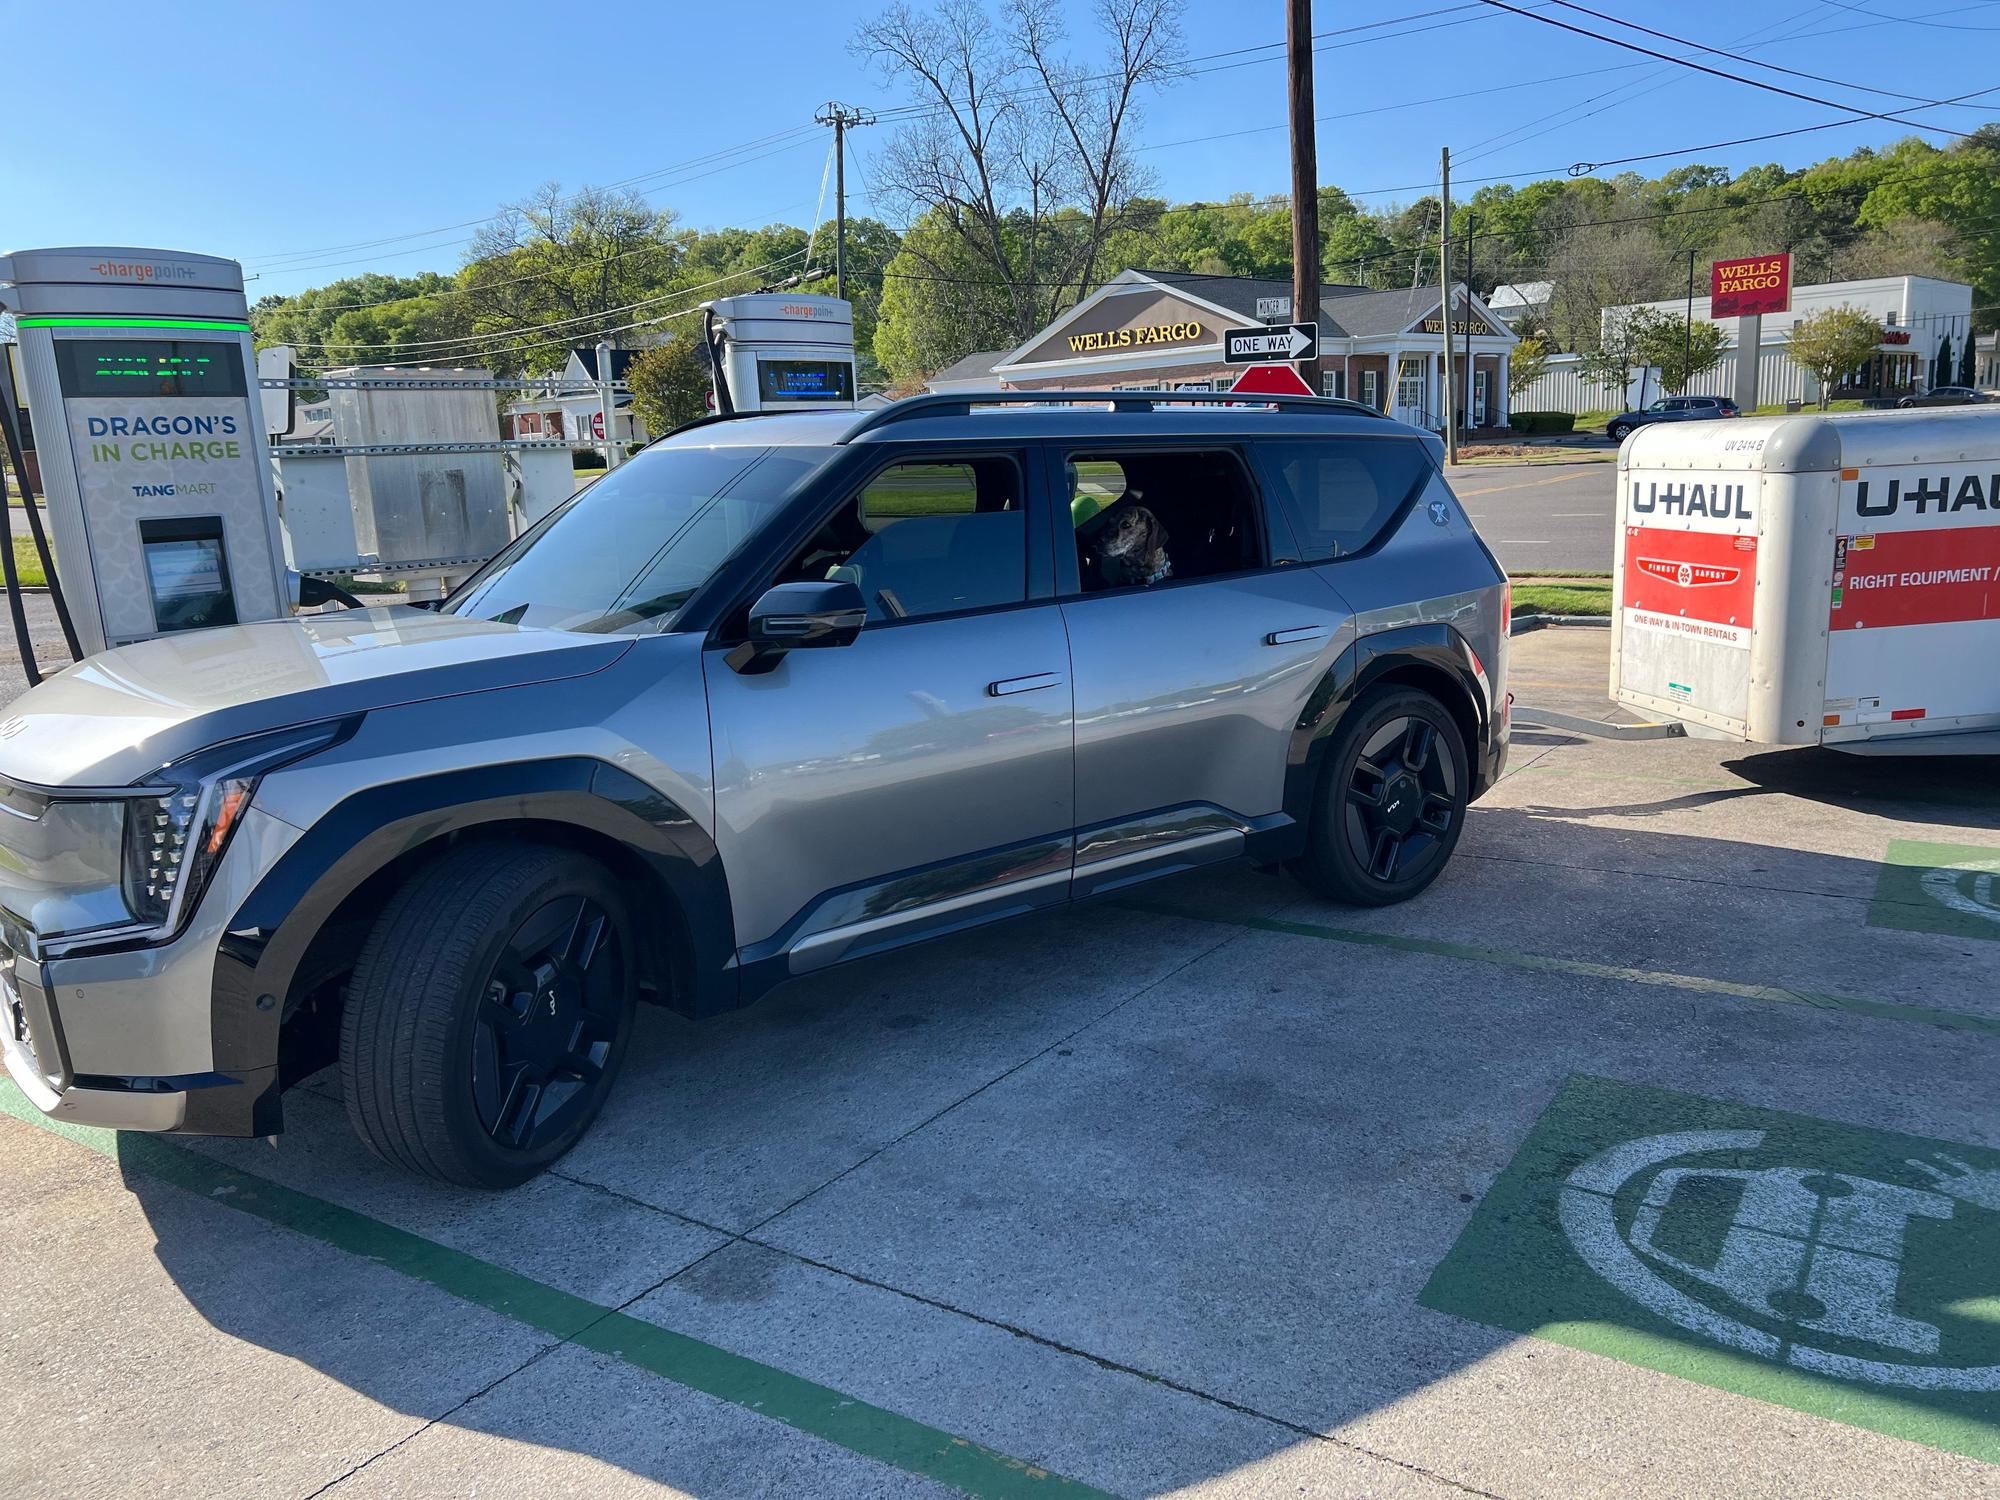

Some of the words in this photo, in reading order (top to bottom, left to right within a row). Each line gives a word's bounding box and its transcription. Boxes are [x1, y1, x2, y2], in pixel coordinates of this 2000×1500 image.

[1718, 260, 1782, 280] WELLS
[1719, 275, 1781, 294] FARGO
[1424, 319, 1457, 334] WELS
[1067, 328, 1132, 353] WELLS
[1134, 321, 1202, 345] FARGO
[1234, 338, 1260, 353] ONE
[1267, 336, 1294, 351] WAY
[88, 416, 237, 437] DRAGON'S
[92, 441, 119, 462] IN
[130, 440, 241, 464] CHARGE
[1725, 439, 1738, 451] UV
[1736, 439, 1756, 451] 2414
[132, 483, 216, 497] TANGMART
[1856, 475, 2000, 517] U-HA
[1648, 563, 1676, 573] FINEST
[1695, 569, 1726, 580] SAFEST
[1849, 573, 1897, 590] RIGHT
[1900, 567, 1992, 587] EQUIPMENT
[1664, 619, 1670, 629] &
[1703, 627, 1738, 642] RENTALS
